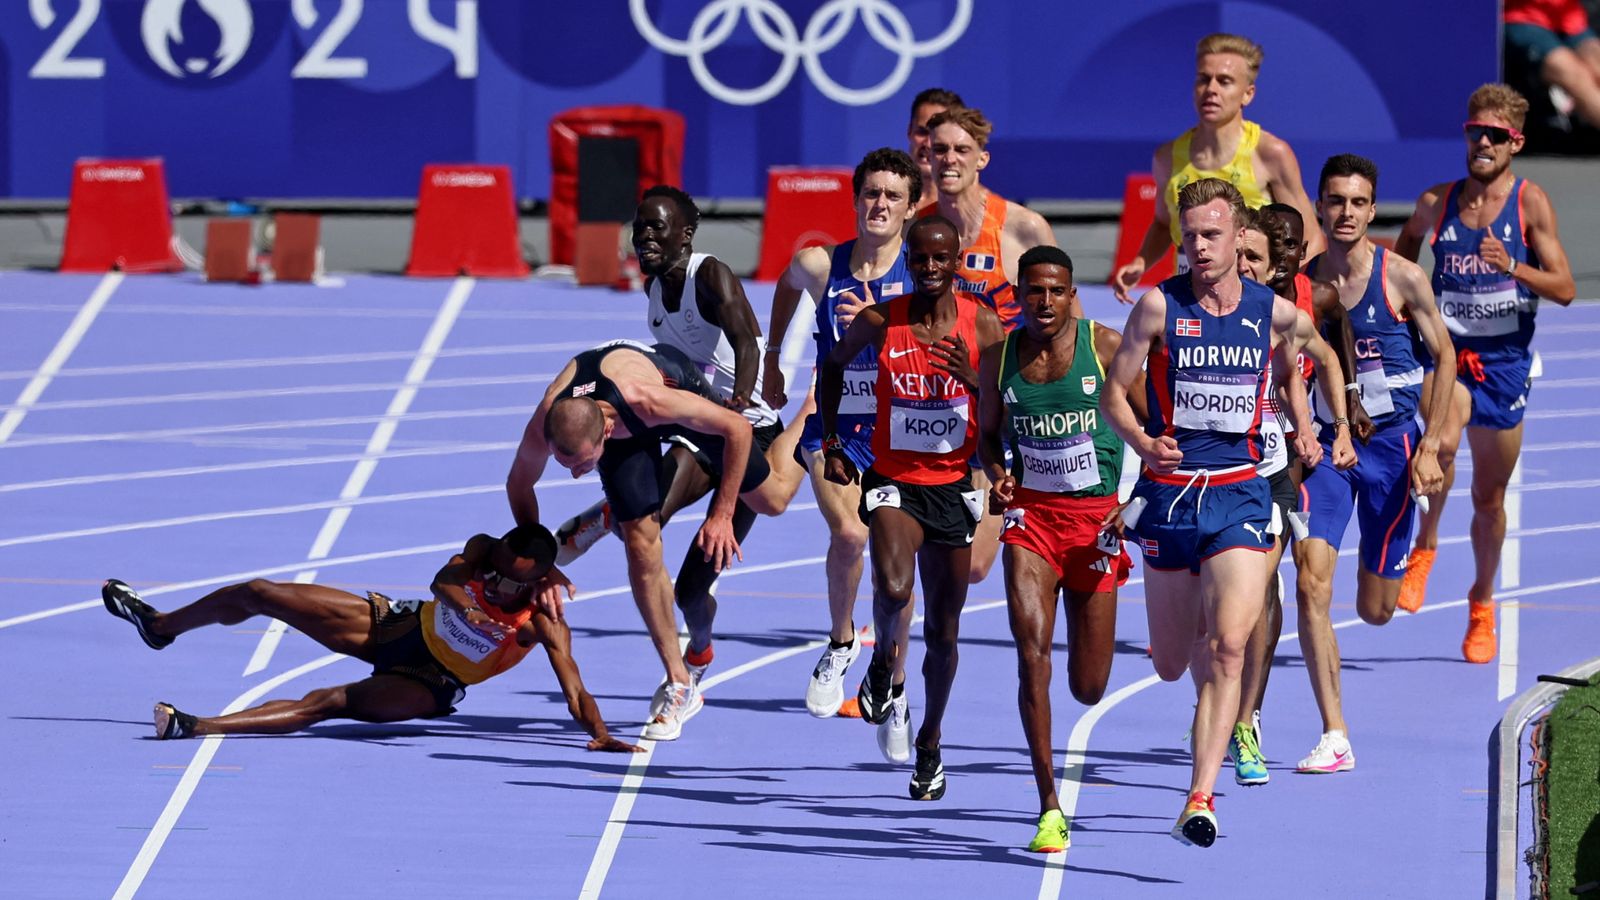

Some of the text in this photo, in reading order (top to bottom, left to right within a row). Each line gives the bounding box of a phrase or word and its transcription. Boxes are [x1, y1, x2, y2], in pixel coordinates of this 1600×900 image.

[1443, 300, 1516, 320] GRESSIER
[1178, 345, 1262, 369] NORWAY
[890, 372, 966, 397] KENYA
[1176, 390, 1255, 413] NORDAS
[905, 417, 958, 436] KROP
[1013, 409, 1097, 436] ETHIOPIA
[1023, 452, 1092, 476] GEBRHIWET
